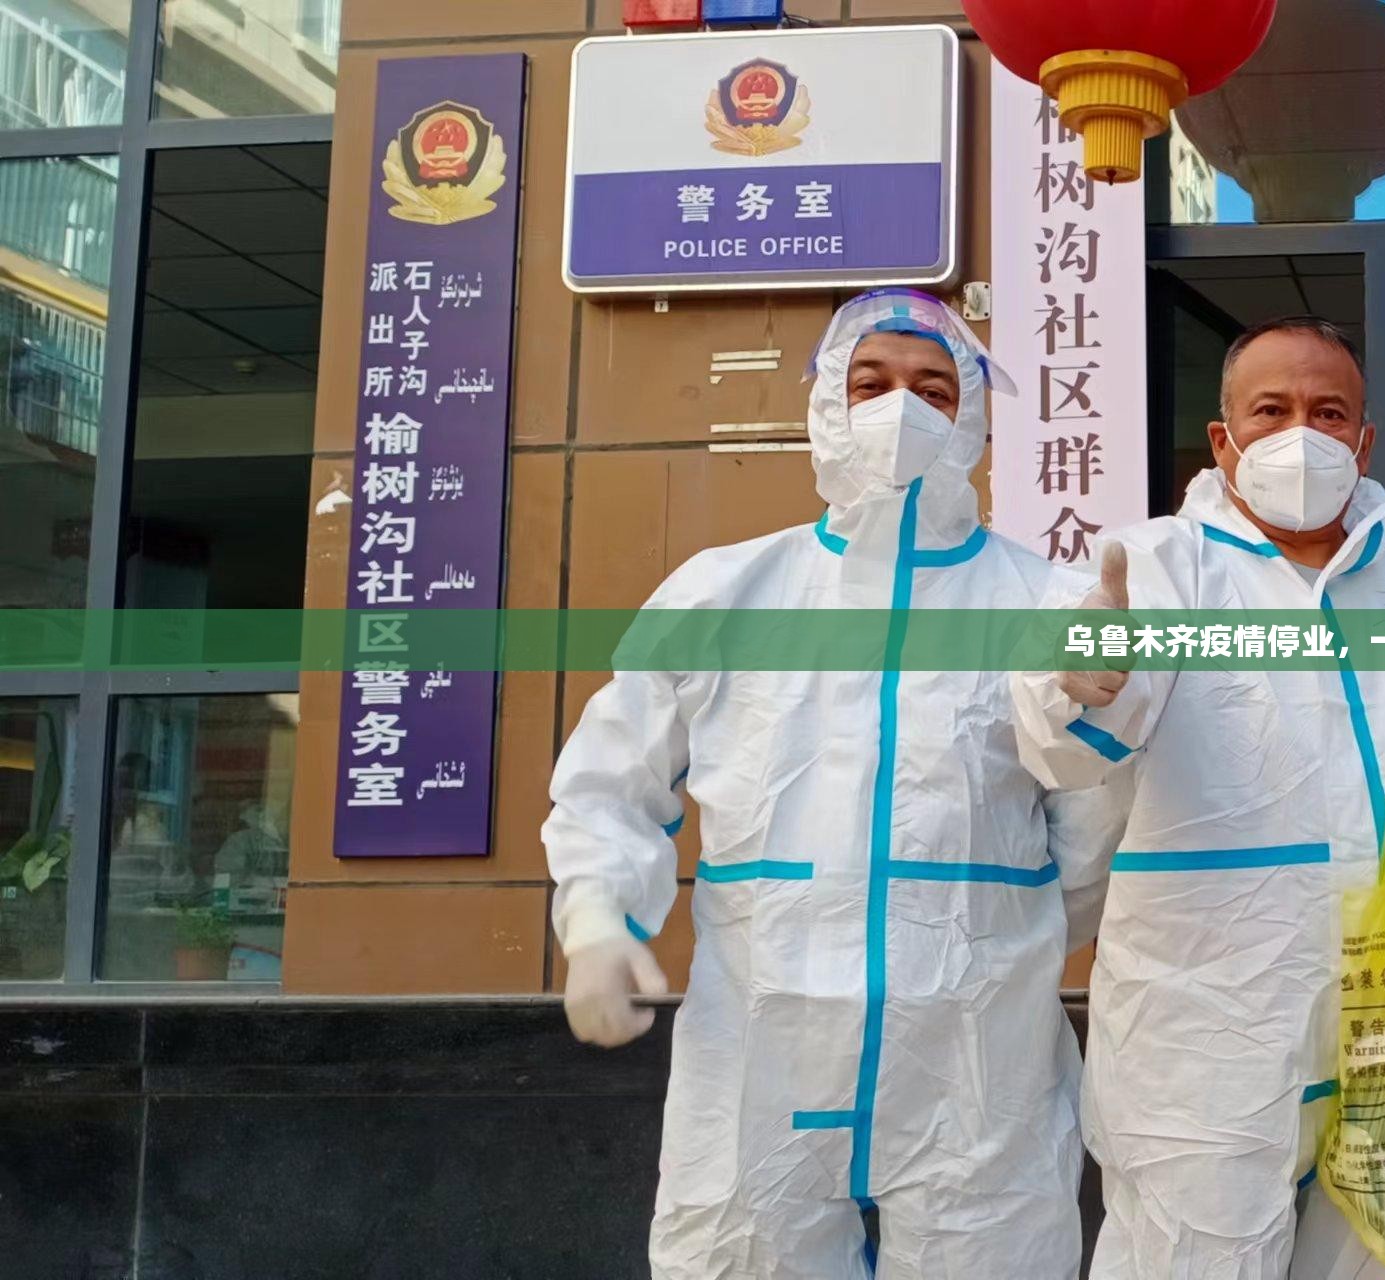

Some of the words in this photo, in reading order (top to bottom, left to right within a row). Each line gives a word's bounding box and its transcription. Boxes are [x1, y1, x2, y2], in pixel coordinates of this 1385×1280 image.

[677, 181, 833, 222] 警务室
[664, 238, 747, 258] POLICE
[760, 235, 844, 256] OFFICE
[364, 261, 398, 397] 派出所
[398, 260, 434, 396] 石人子沟
[347, 412, 423, 807] 榆树沟社区警务室
[1350, 1017, 1385, 1037] 警告
